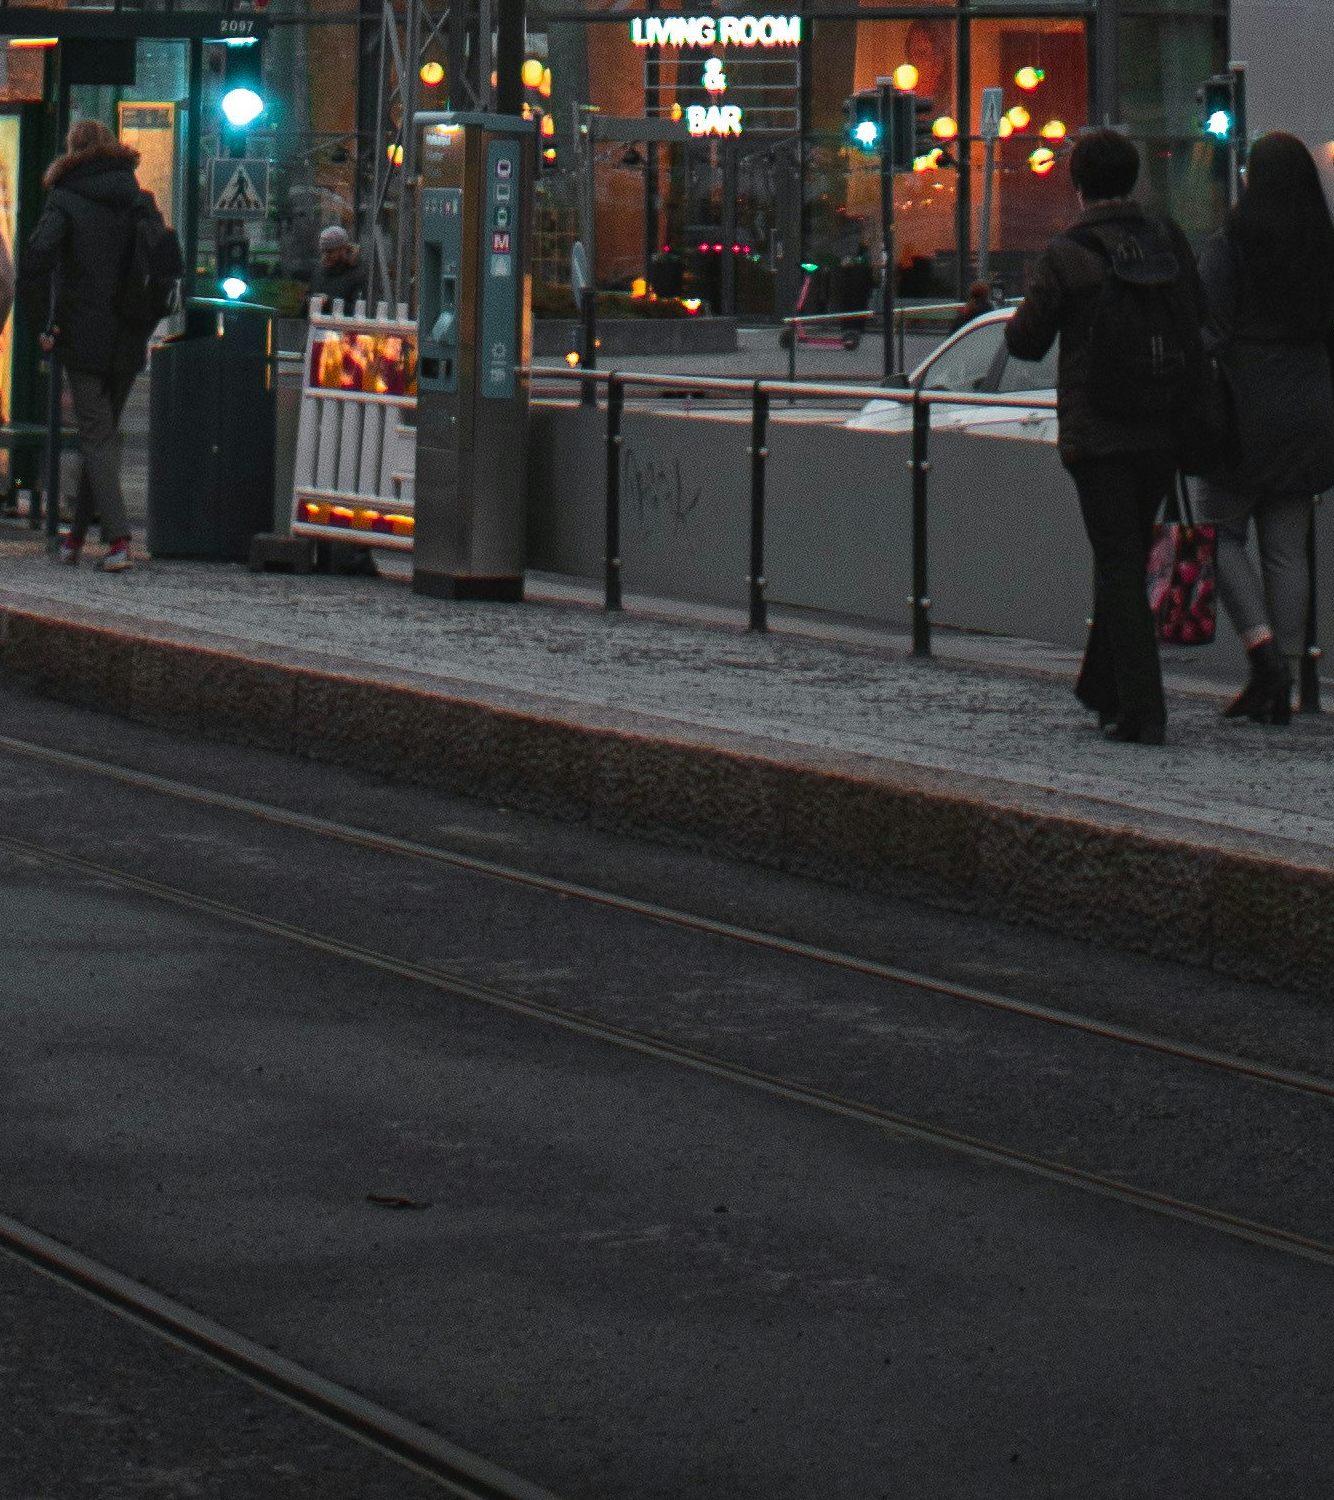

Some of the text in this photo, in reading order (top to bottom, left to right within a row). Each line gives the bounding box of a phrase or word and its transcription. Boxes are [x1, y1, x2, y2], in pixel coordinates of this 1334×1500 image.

[219, 19, 255, 33] 2097
[630, 15, 801, 48] LIVING ROOM
[701, 57, 728, 95] &
[685, 103, 743, 138] BAR
